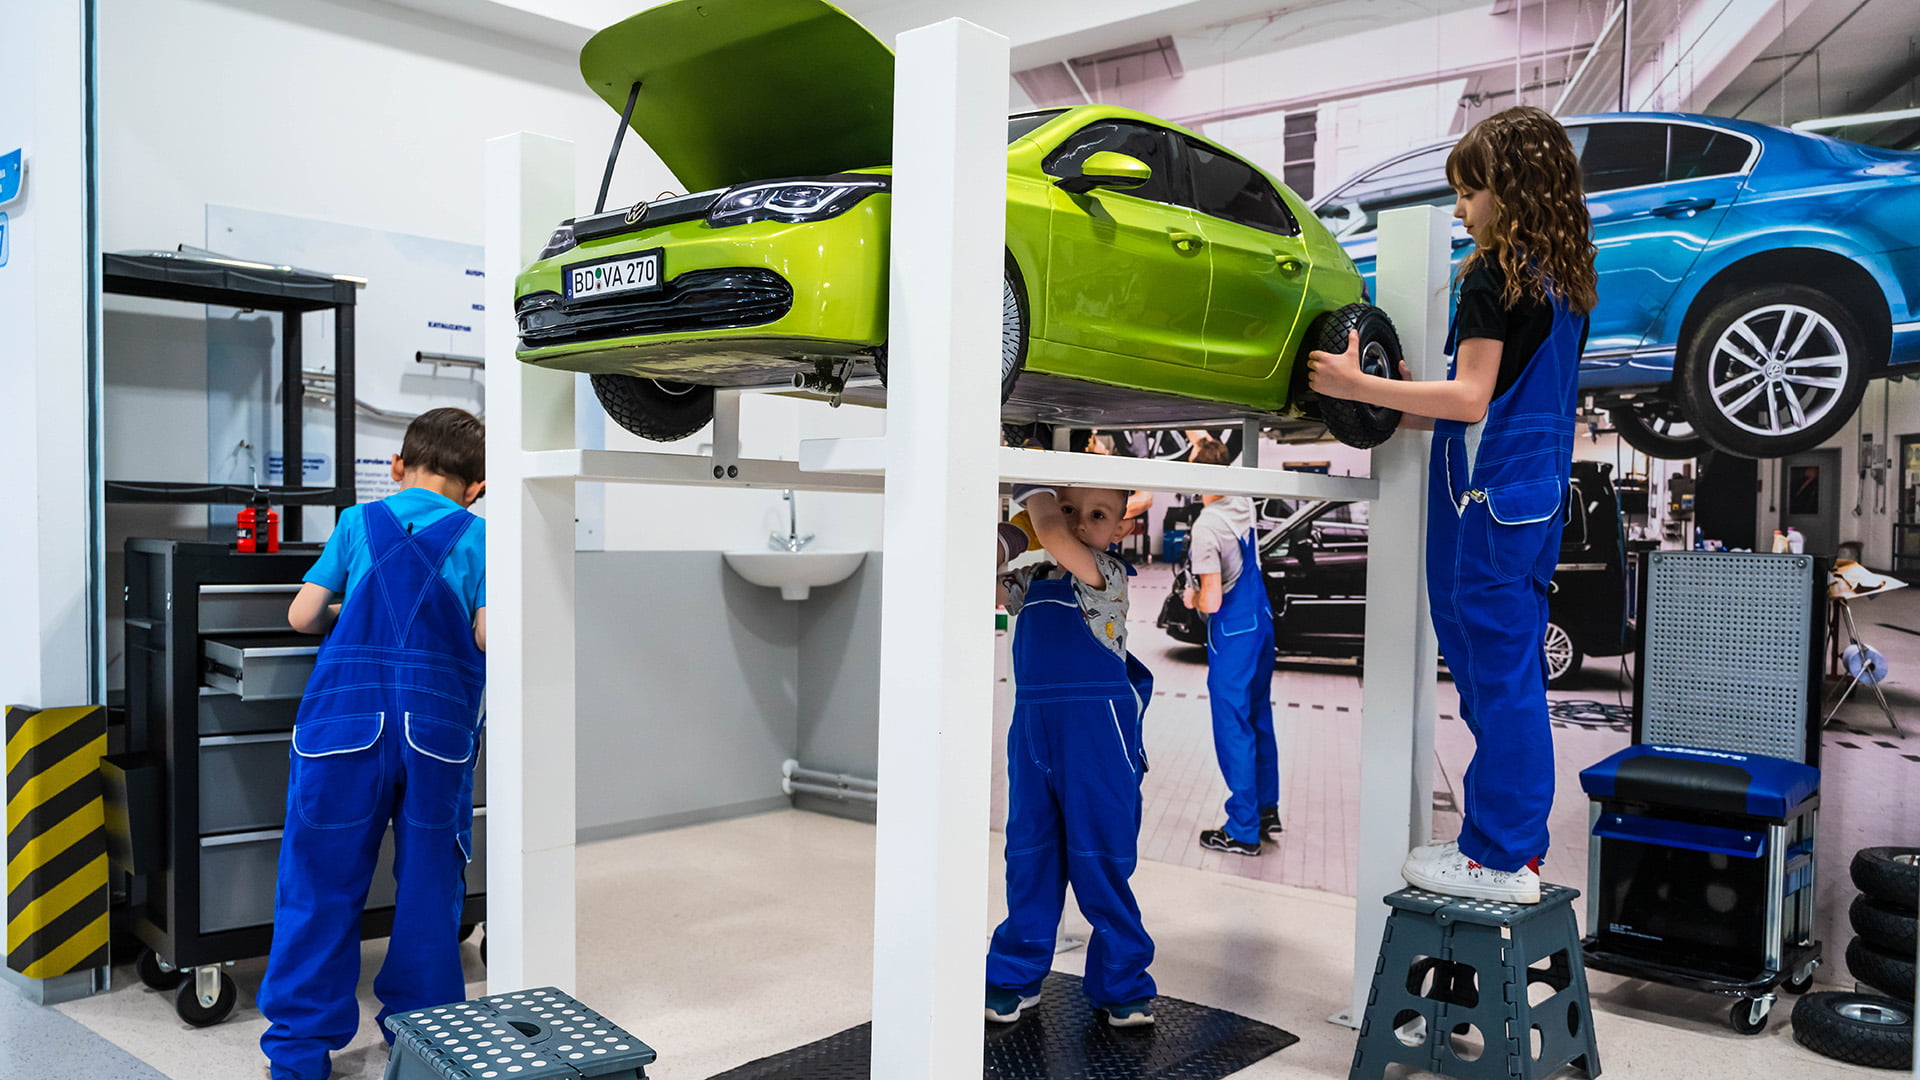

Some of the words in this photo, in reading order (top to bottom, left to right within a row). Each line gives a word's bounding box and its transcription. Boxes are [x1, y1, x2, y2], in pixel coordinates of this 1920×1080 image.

[574, 270, 594, 293] BD
[602, 265, 623, 288] VA
[626, 259, 655, 284] 270
